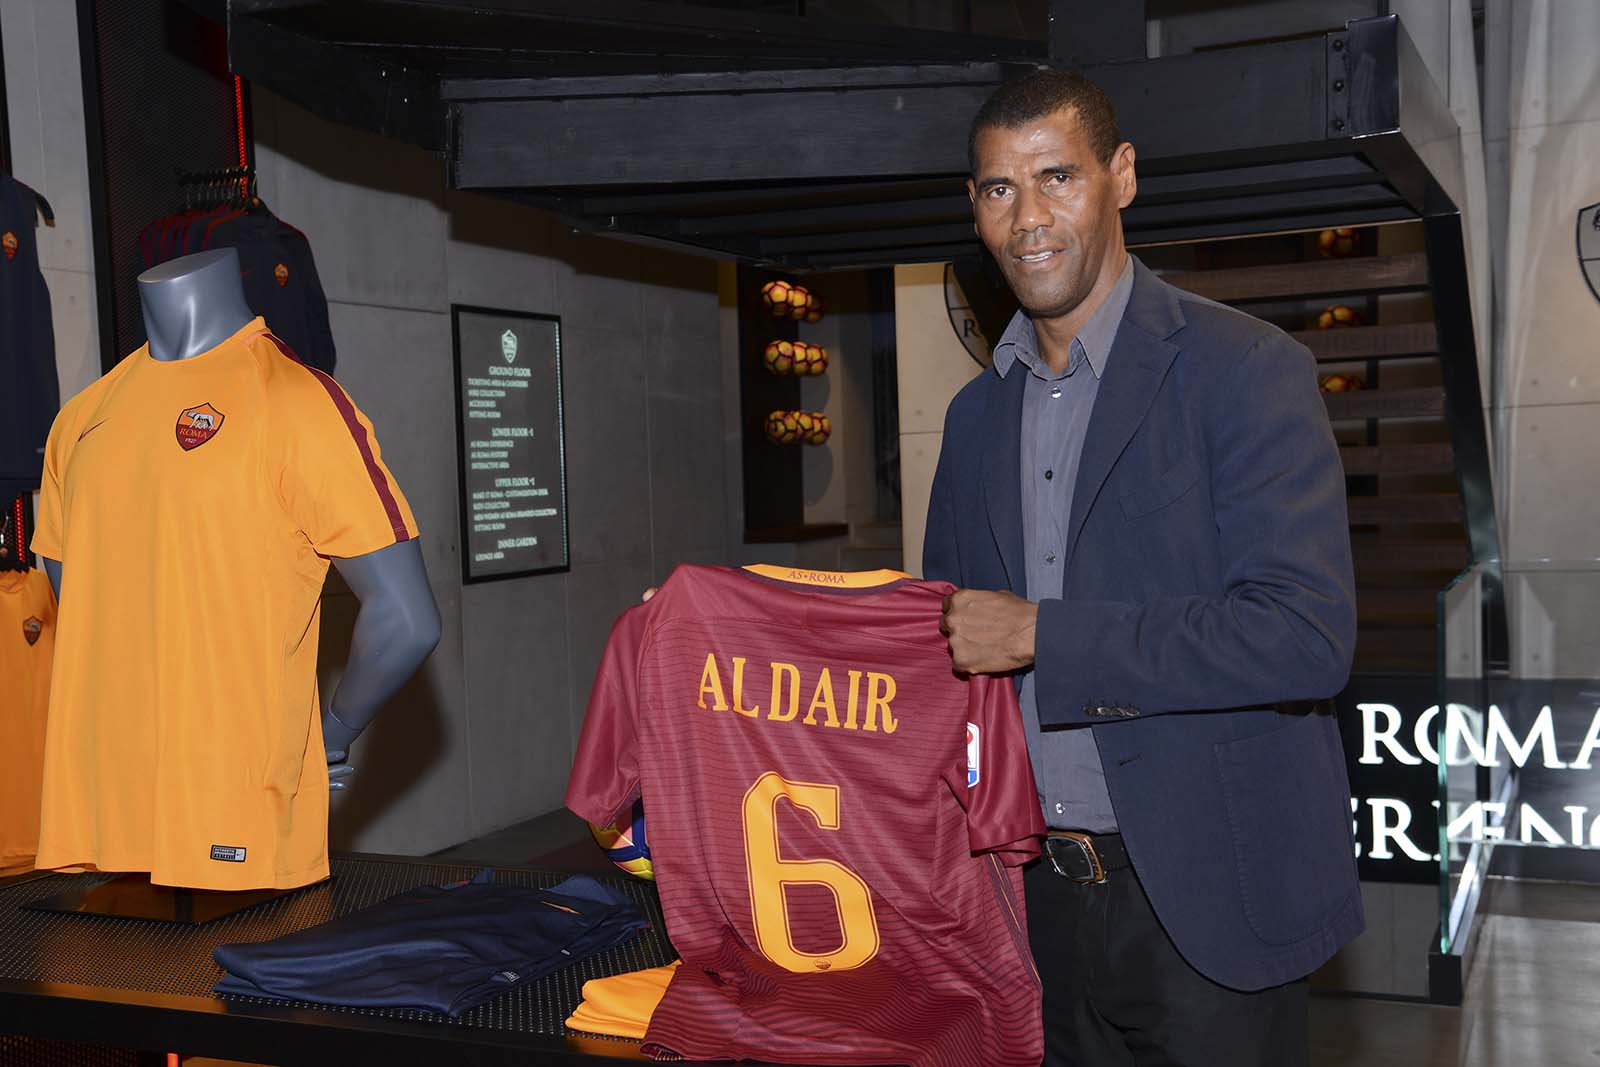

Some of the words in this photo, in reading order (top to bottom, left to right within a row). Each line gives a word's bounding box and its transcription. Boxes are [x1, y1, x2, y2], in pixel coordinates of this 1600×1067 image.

[180, 428, 208, 439] ROMA
[697, 652, 899, 734] ALDAIR
[742, 770, 880, 974] 6
